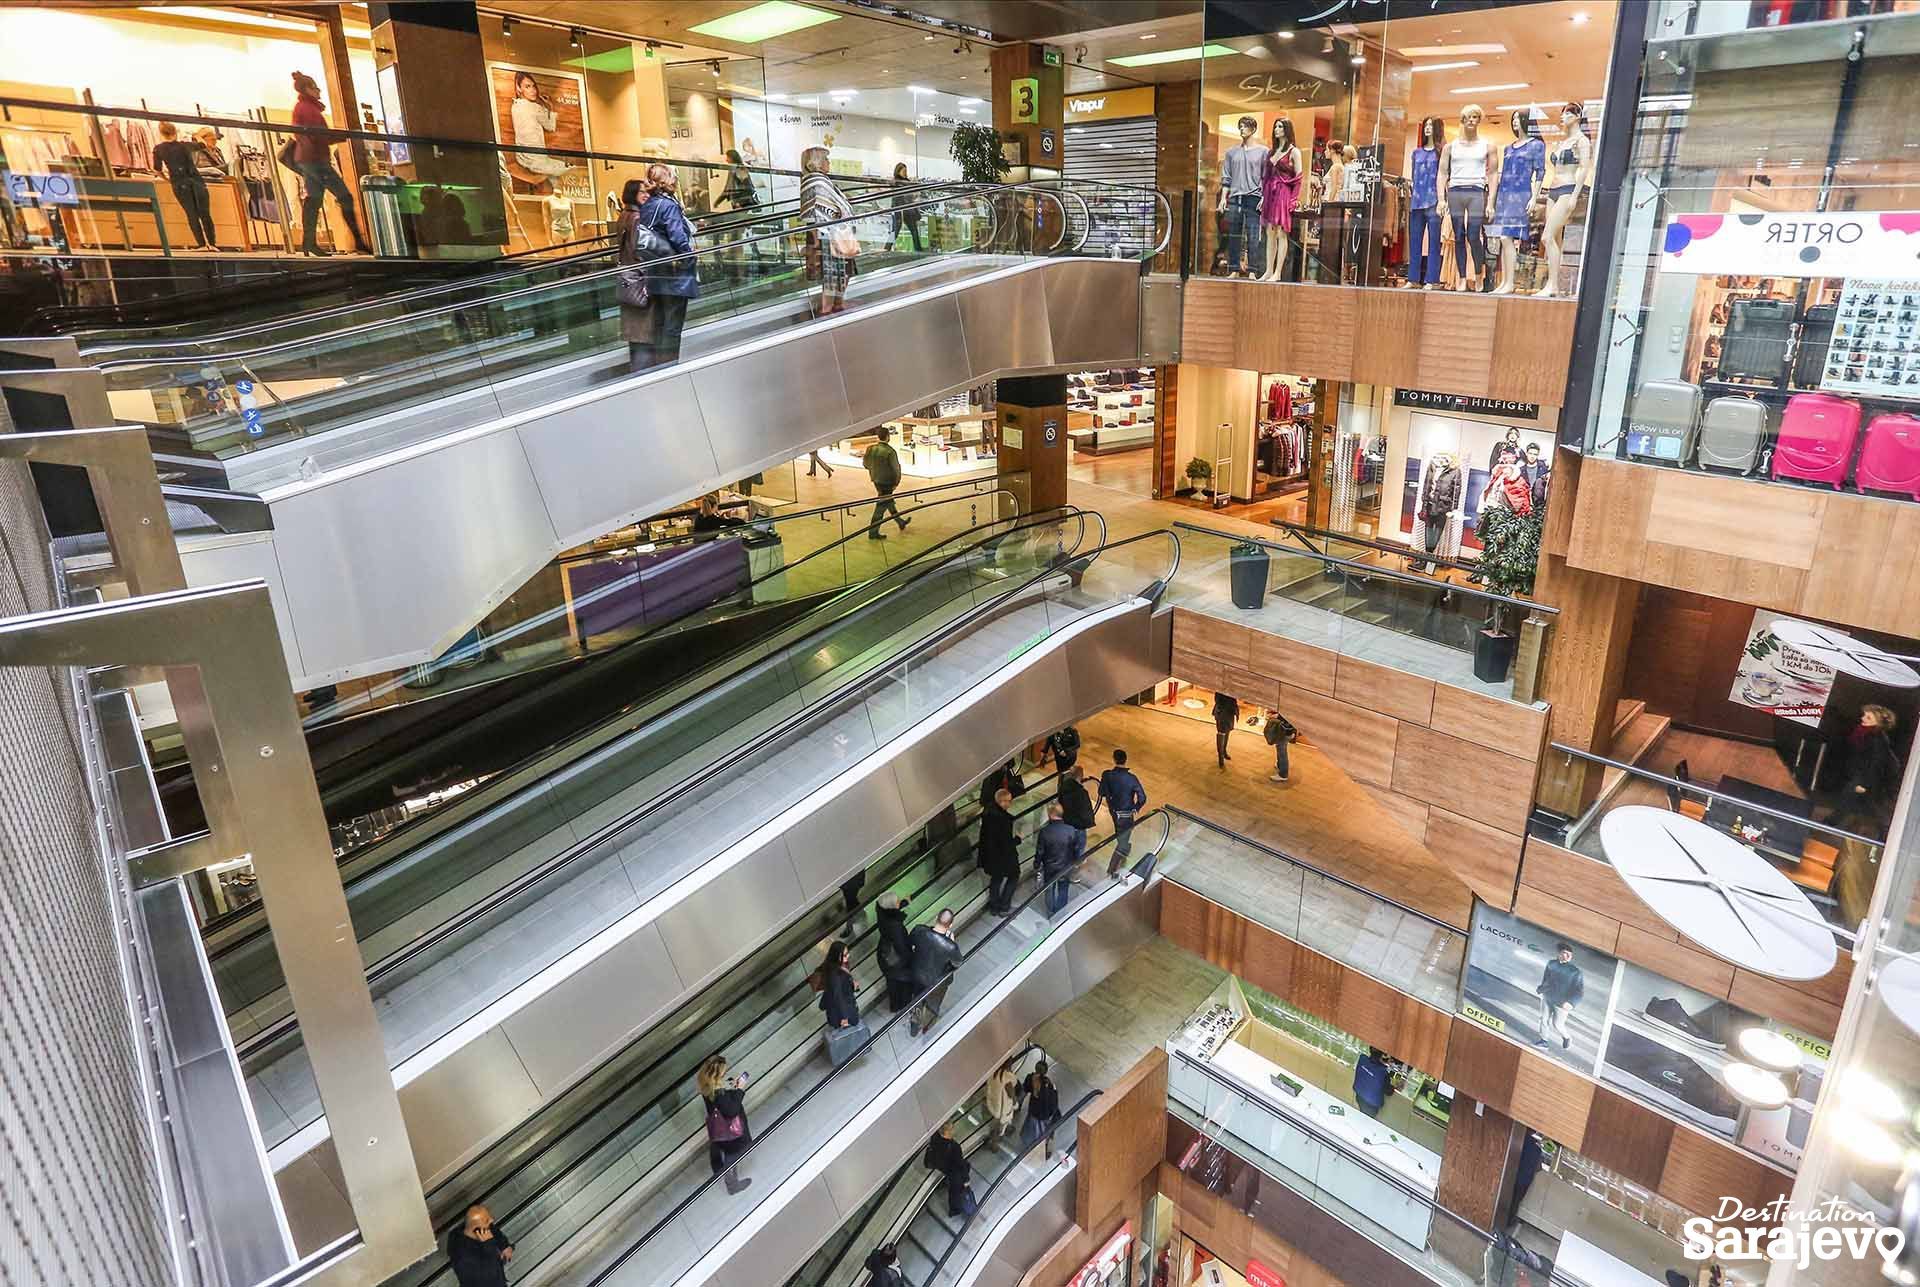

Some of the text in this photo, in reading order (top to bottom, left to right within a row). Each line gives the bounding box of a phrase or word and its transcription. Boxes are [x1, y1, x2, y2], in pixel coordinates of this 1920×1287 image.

[1238, 74, 1322, 104] Skiny
[1019, 86, 1034, 118] 3
[1400, 391, 1533, 412] TOMMY HILFIGER
[1480, 923, 1522, 946] LACOSTE
[1466, 1007, 1501, 1028] OFFICE
